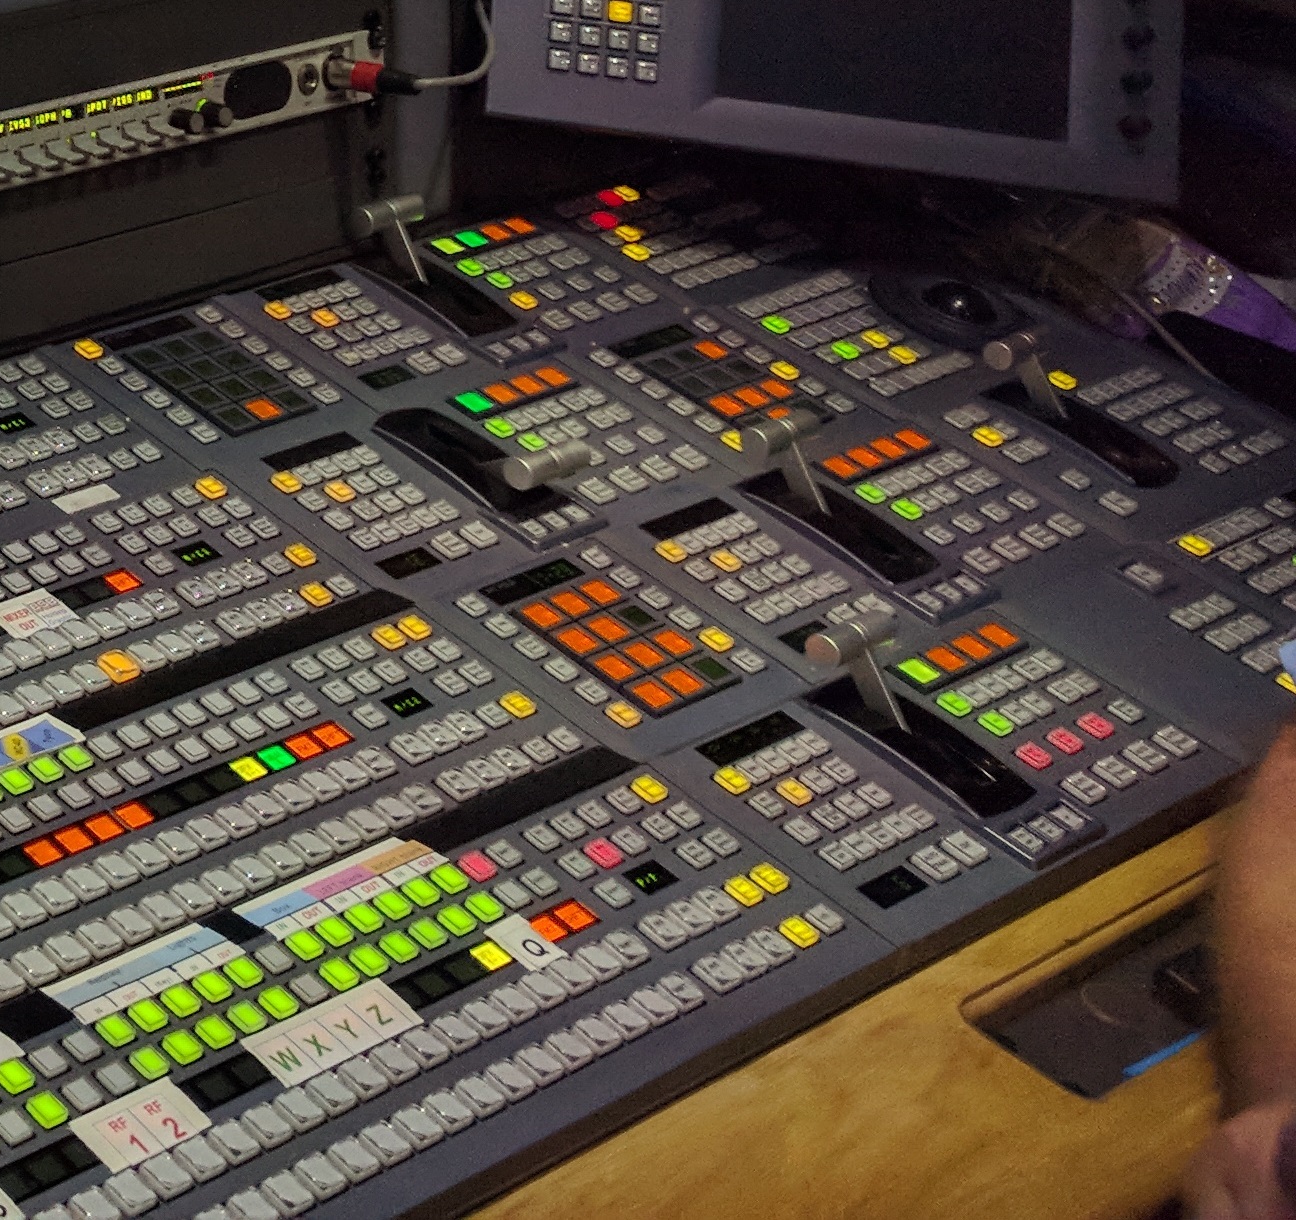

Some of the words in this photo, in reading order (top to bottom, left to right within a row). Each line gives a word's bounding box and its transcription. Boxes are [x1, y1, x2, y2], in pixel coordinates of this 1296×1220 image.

[18, 620, 38, 631] OUT
[418, 856, 437, 868] OUT
[360, 881, 379, 893] OUT
[302, 906, 323, 919] OUT
[521, 938, 546, 957] Q
[269, 1046, 304, 1072] W
[303, 1033, 333, 1057] X
[334, 1018, 359, 1039] Y
[366, 1003, 393, 1026] Z
[144, 1099, 165, 1117] RF
[109, 1116, 130, 1135] RF
[161, 1117, 186, 1142] 2
[130, 1134, 150, 1154] 1
